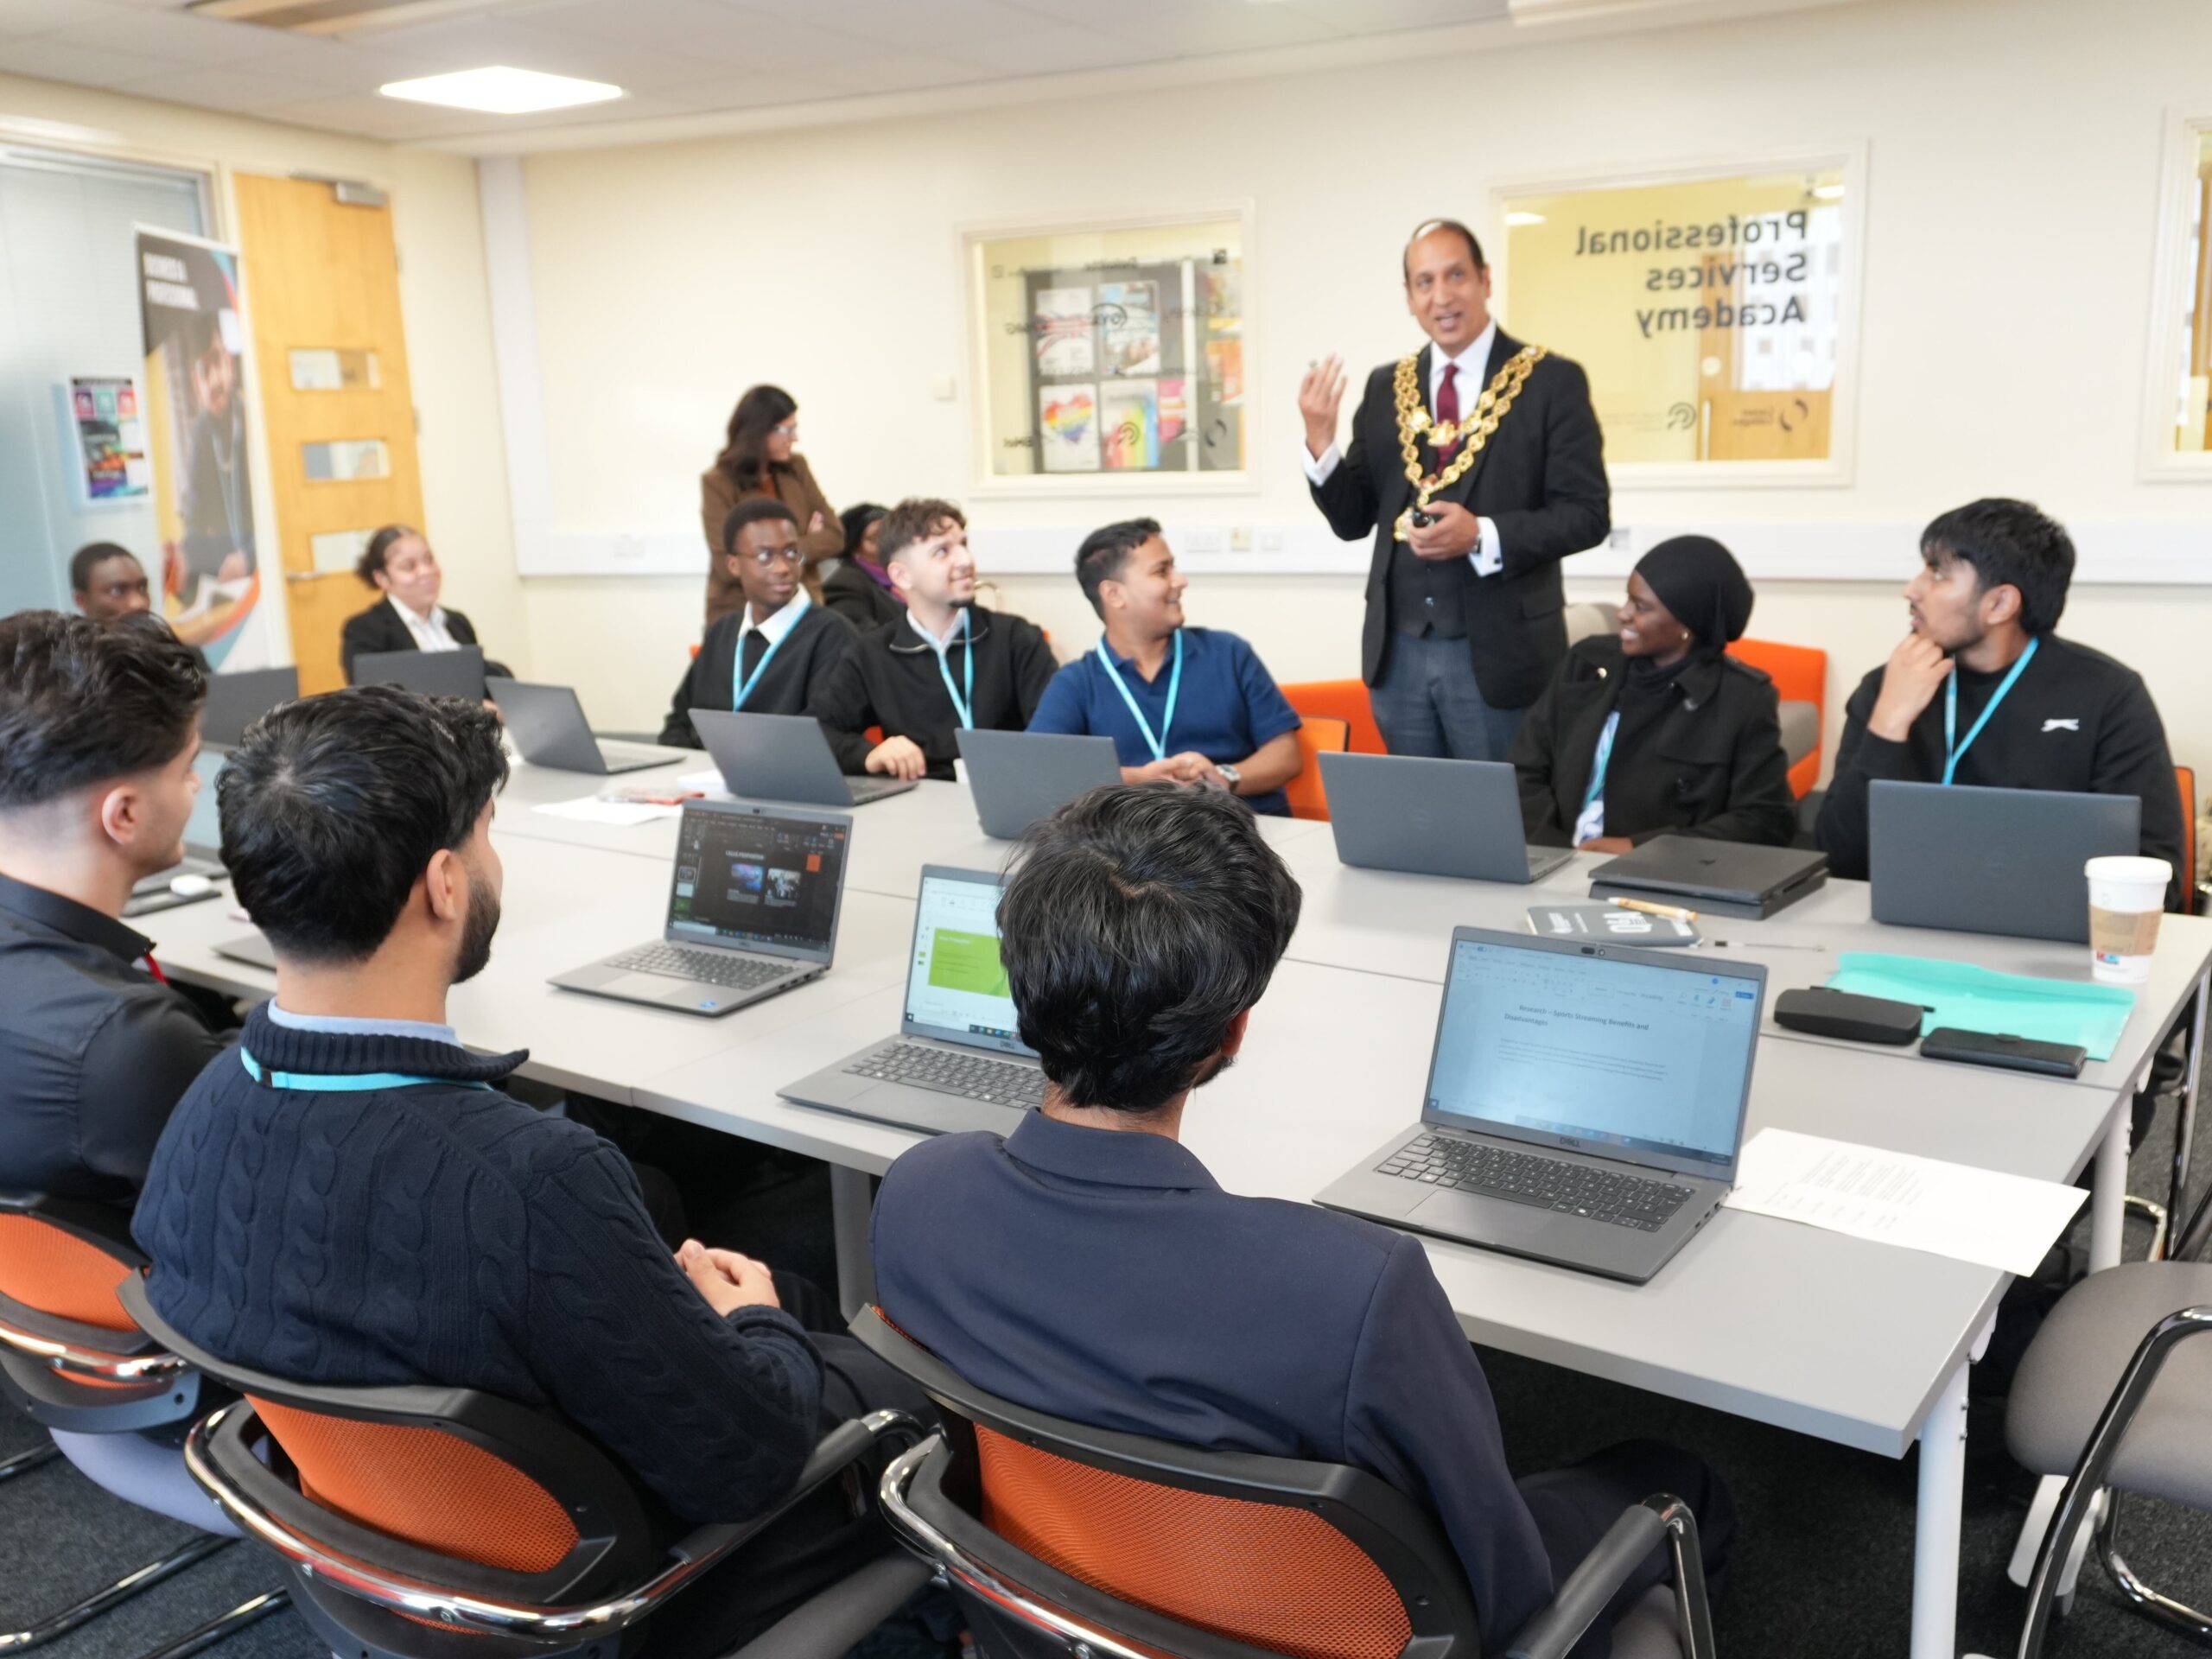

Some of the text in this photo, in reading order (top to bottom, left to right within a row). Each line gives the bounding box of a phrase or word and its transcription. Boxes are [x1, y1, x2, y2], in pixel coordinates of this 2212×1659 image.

[1503, 1013, 1548, 1027] Disadvantages
[1519, 1005, 1547, 1014] Research
[1553, 1009, 1573, 1020] Sports
[1575, 1013, 1607, 1026] Streaming
[1609, 1018, 1635, 1028] Benefits
[1559, 1135, 1581, 1147] DELL
